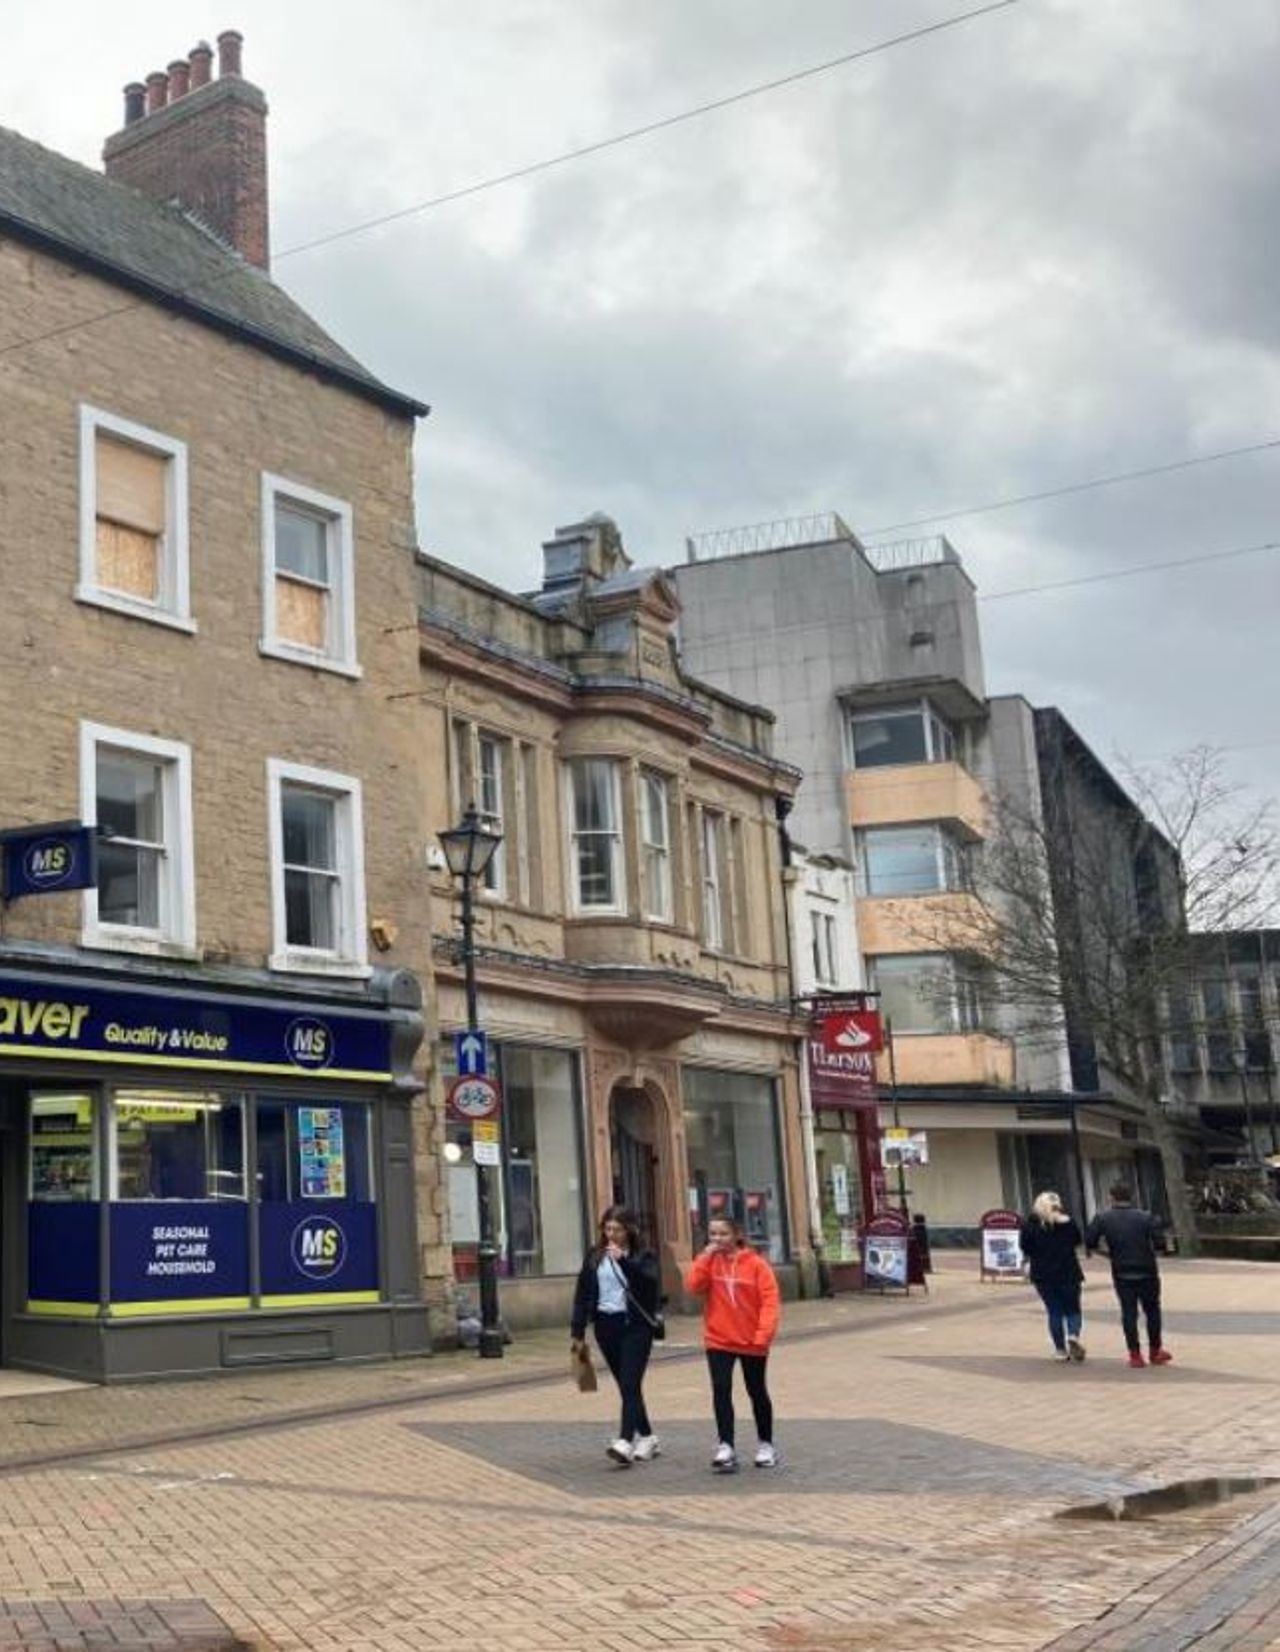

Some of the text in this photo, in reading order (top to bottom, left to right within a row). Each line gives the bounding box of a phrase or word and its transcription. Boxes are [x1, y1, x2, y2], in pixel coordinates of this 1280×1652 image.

[31, 846, 66, 871] MS
[104, 1022, 168, 1050] Quality
[181, 1030, 229, 1051] Value
[293, 1027, 327, 1053] MS
[152, 1226, 209, 1240] SEASONAL
[302, 1228, 338, 1257] MS
[155, 1243, 208, 1258] PET CARE
[146, 1260, 216, 1276] HOUSEHOLD
